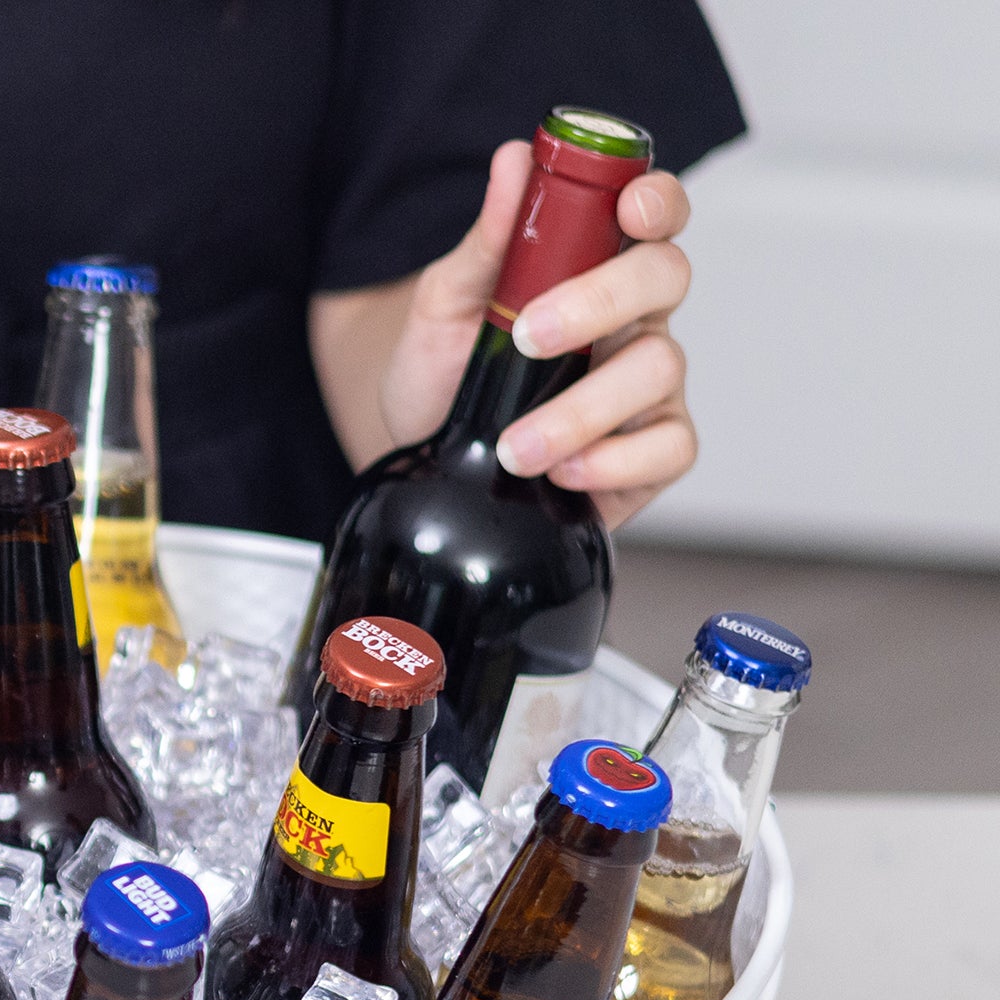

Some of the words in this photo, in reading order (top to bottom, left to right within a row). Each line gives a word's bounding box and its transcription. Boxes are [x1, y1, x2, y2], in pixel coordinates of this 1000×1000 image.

[341, 624, 426, 676] BOCK
[355, 619, 435, 666] BRECKEN
[716, 616, 806, 659] MONTERREY
[112, 876, 172, 925] LIGHT
[132, 874, 178, 912] BUD
